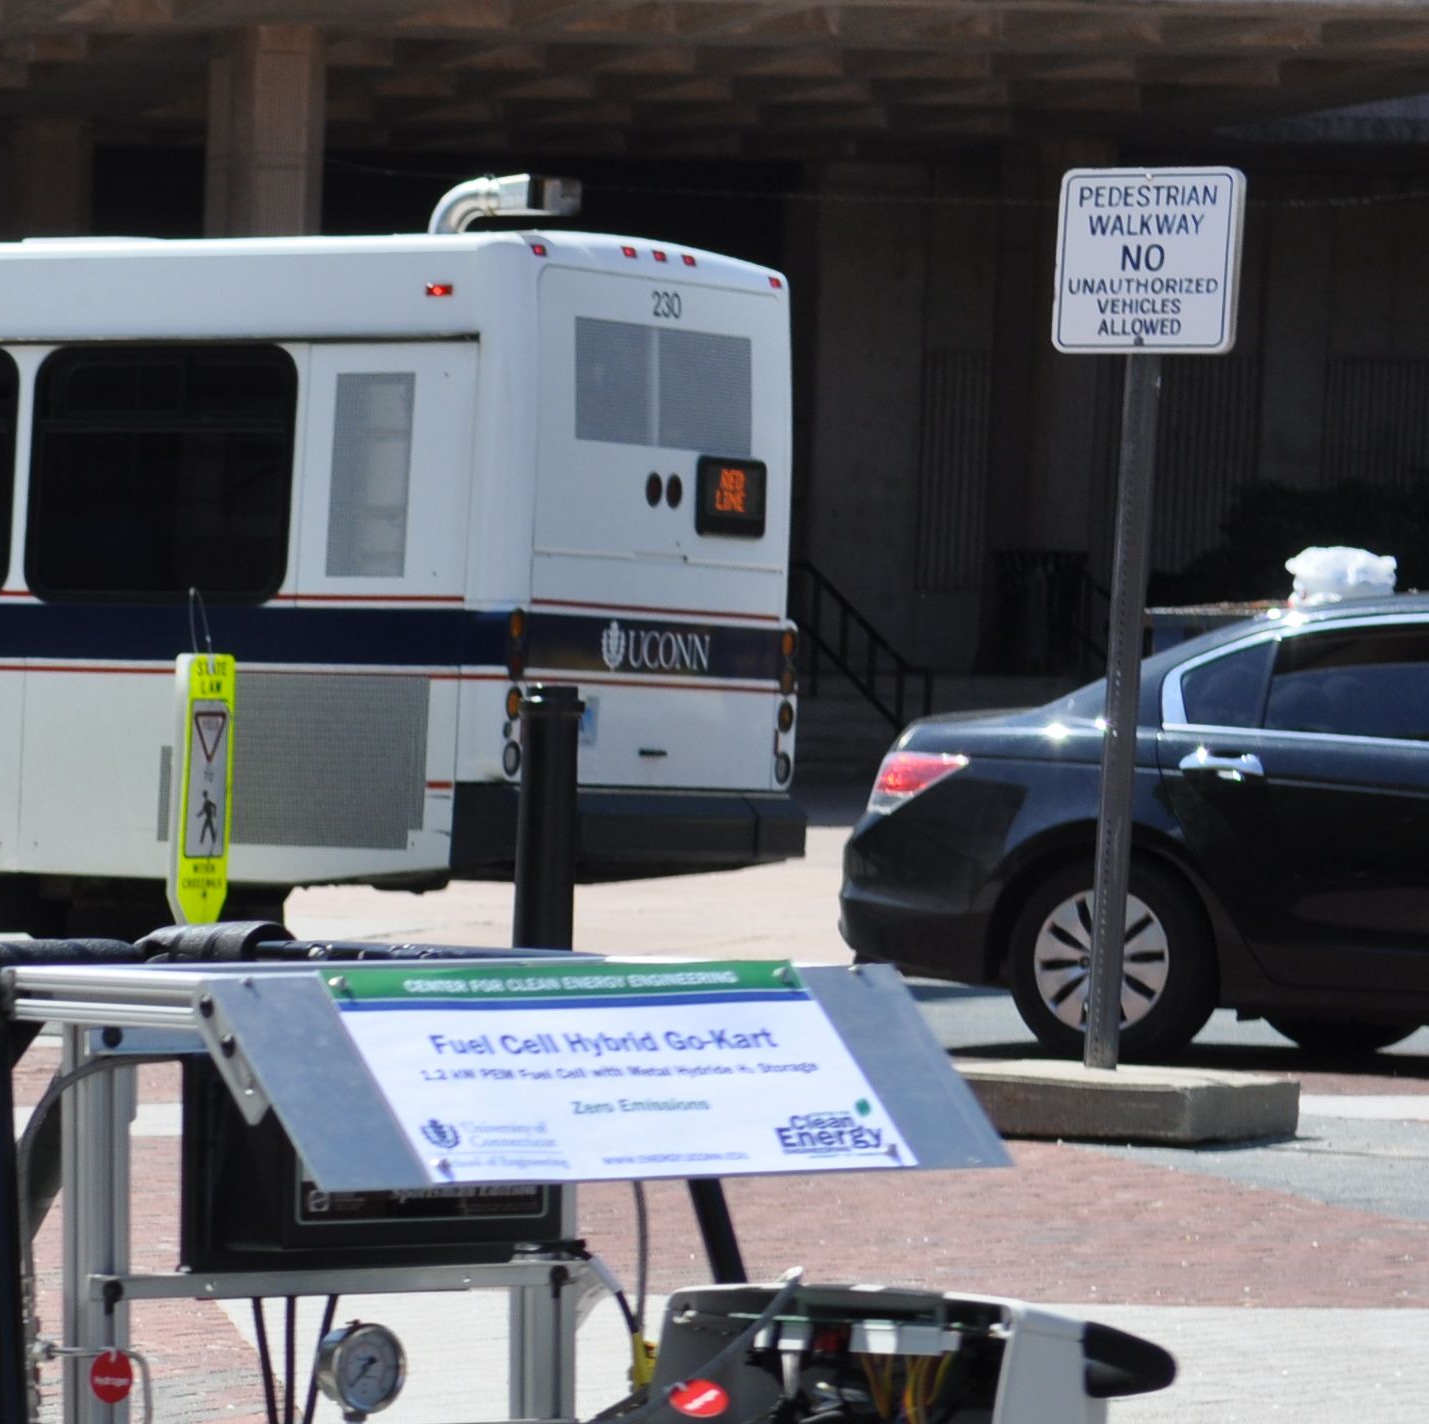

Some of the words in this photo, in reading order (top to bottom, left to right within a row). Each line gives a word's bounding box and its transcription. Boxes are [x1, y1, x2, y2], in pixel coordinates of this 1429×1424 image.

[1078, 184, 1219, 208] PEDESTRIAN
[1088, 213, 1205, 237] WALKWAY
[1120, 243, 1166, 272] NO
[1067, 277, 1219, 295] UNAUTHORIZED
[651, 291, 683, 319] 230
[1096, 298, 1182, 315] VEHICLES
[1097, 318, 1182, 337] ALLOWED
[627, 633, 711, 672] UCONN
[403, 979, 469, 993] CENTER
[469, 978, 505, 992] FOR
[506, 976, 561, 991] CLEAN
[561, 974, 626, 990] ENERGY
[627, 970, 739, 988] ENGINEERING
[427, 1033, 496, 1055] Fuel
[499, 1032, 561, 1055] Cell
[562, 1030, 660, 1058] Hybrid
[662, 1027, 780, 1050] Go-Kart
[419, 1069, 449, 1082] 1.2
[518, 1068, 554, 1081] Fuel
[555, 1067, 586, 1080] Cell
[592, 1066, 624, 1078] with
[627, 1066, 672, 1077] Metal
[677, 1064, 735, 1079] Hydride
[756, 1062, 820, 1075] Storage
[570, 1100, 614, 1115] Zero
[617, 1098, 711, 1112] Emissions
[789, 1114, 855, 1130] Clean
[774, 1126, 883, 1150] Energy
